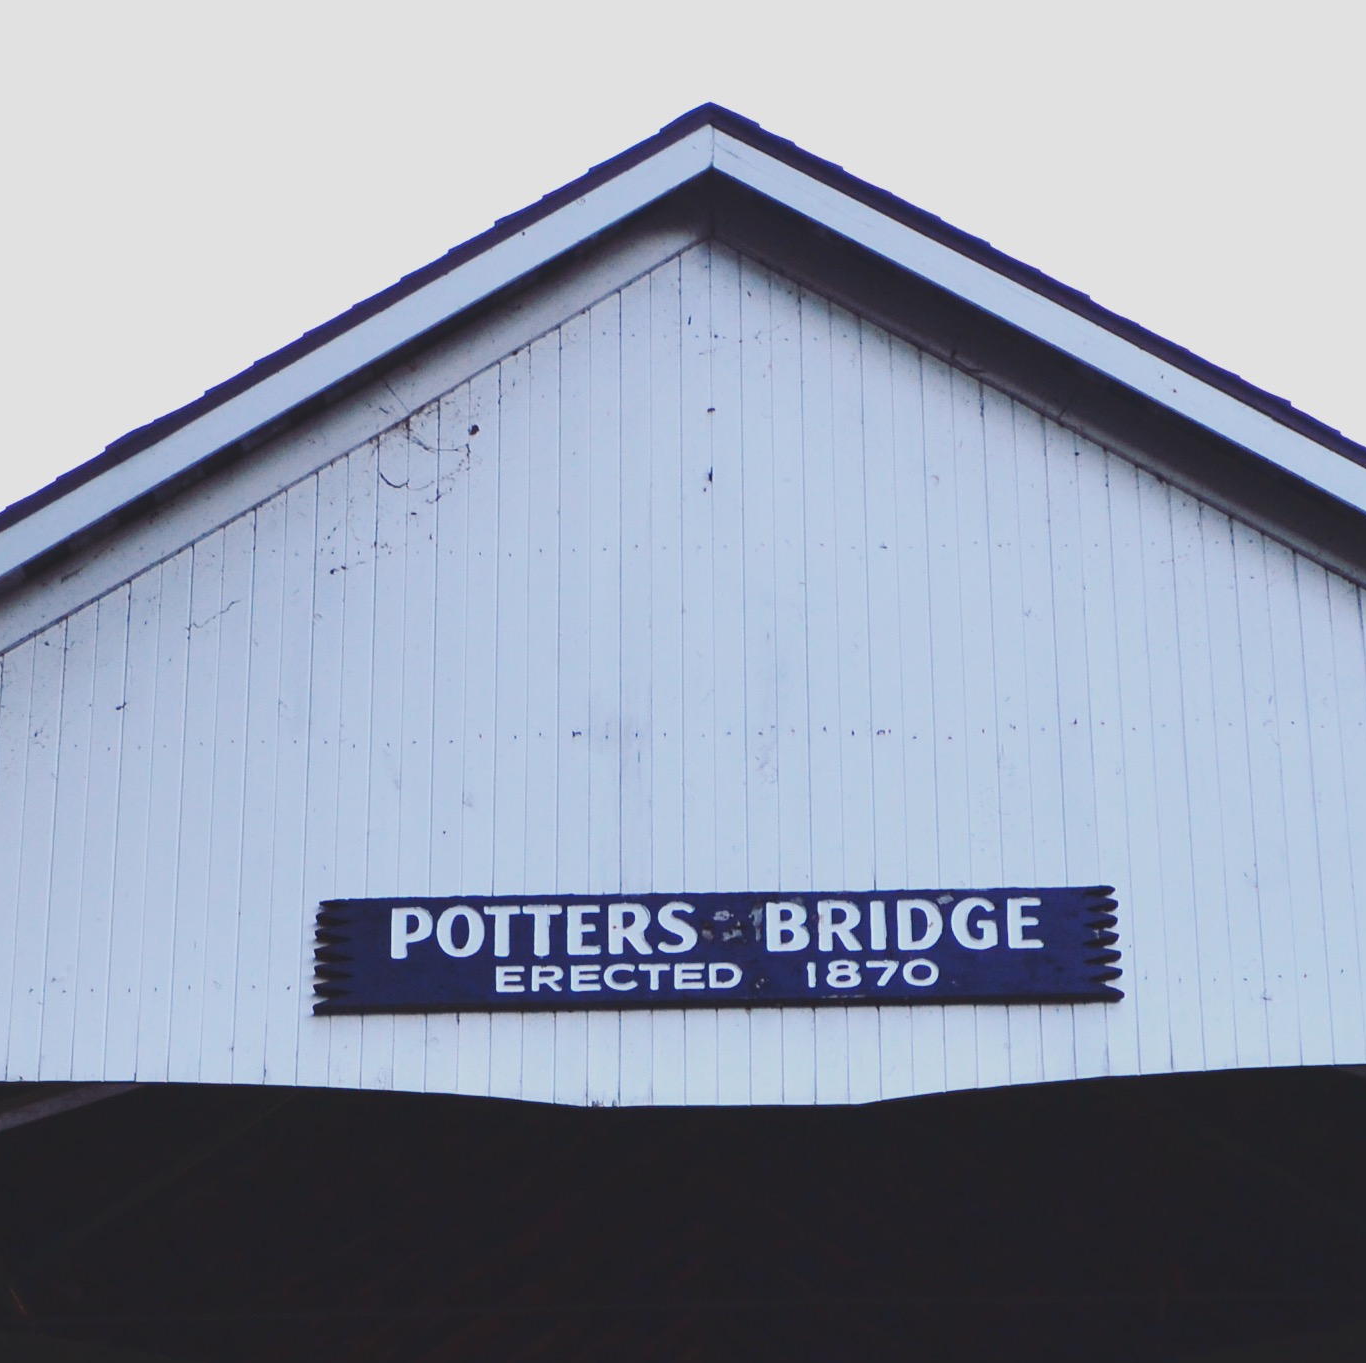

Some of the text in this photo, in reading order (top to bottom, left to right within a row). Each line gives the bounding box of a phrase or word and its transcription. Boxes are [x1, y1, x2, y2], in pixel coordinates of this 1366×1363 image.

[391, 895, 1045, 959] POTTERS BRIDGE
[494, 958, 942, 994] ERECTED 1870
